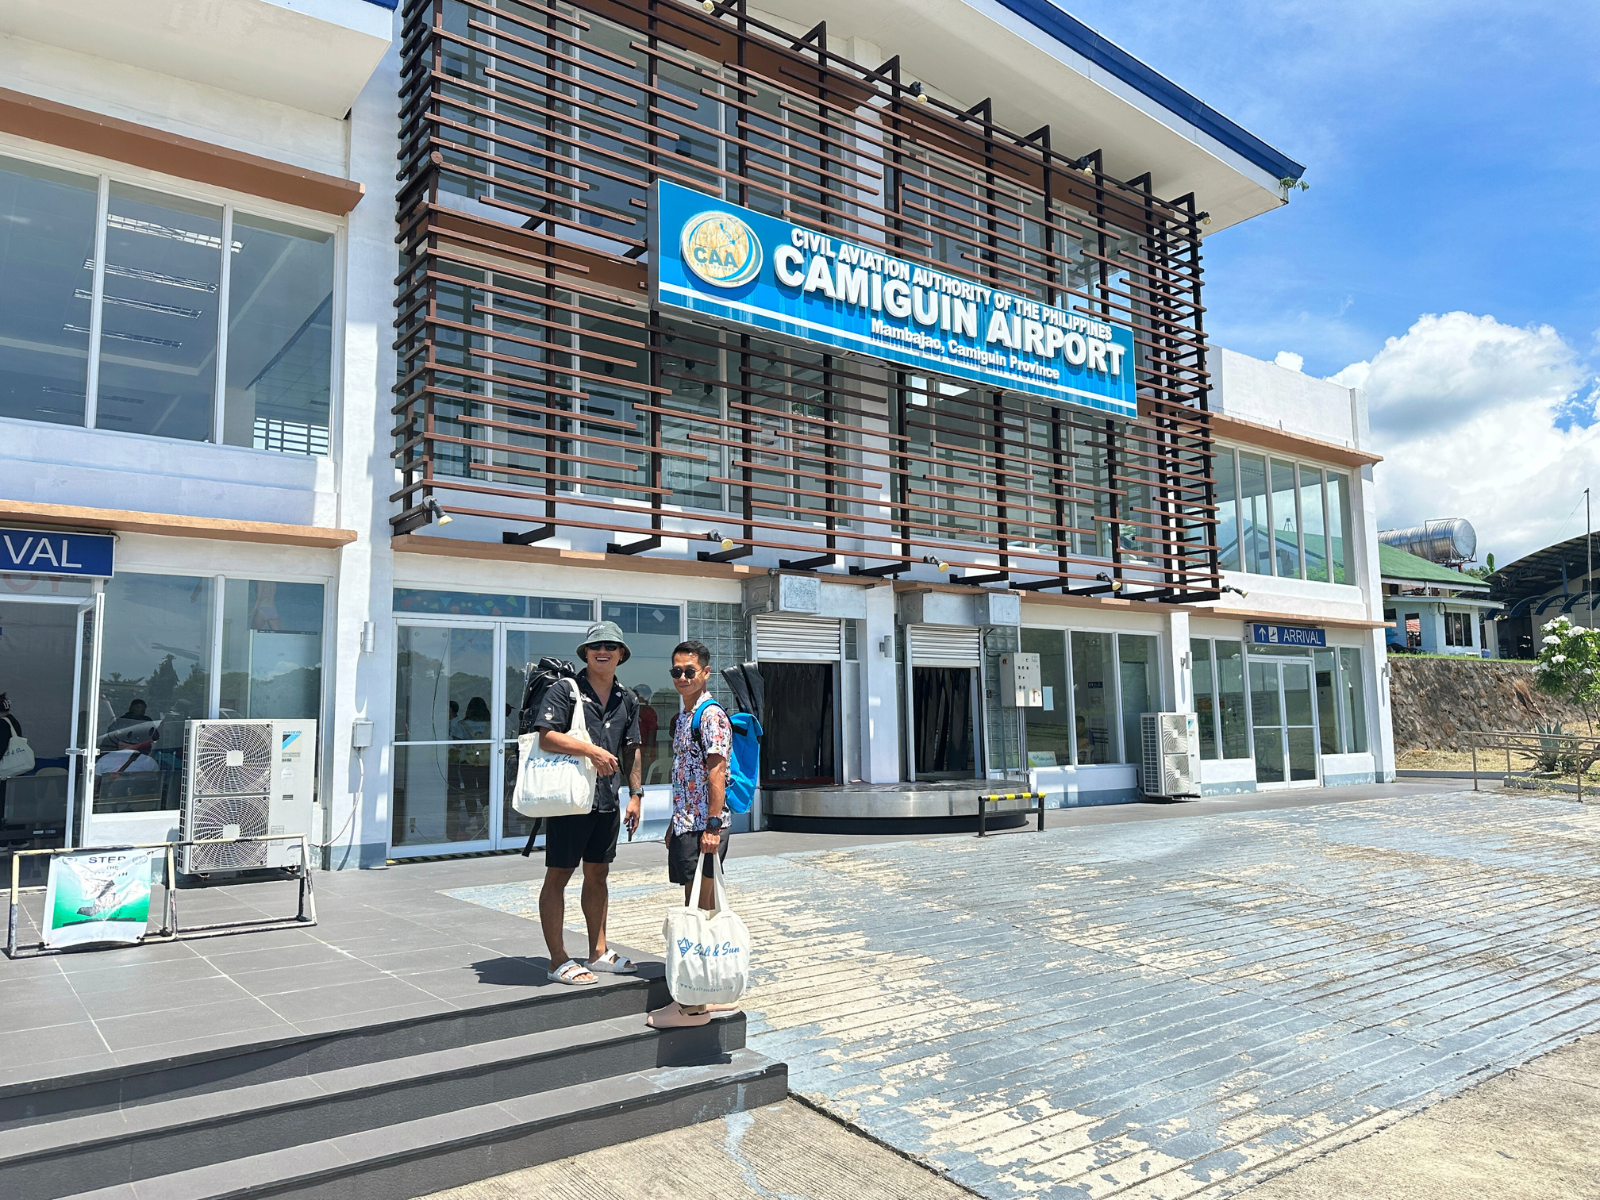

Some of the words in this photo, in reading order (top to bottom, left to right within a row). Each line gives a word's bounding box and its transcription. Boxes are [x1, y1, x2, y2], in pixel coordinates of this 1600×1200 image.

[693, 246, 739, 269] CAA
[791, 228, 836, 258] CIVIL
[838, 243, 911, 281] AVIATION
[912, 267, 992, 305] AUTHORITY
[993, 292, 1012, 313] OF
[1014, 299, 1040, 320] THE
[1042, 307, 1112, 341] PHILIPPINES
[774, 244, 978, 338] CAMIGUIN
[986, 311, 1125, 376] AIRPORT
[871, 318, 945, 354] Mambajao,
[948, 340, 1007, 367] Camiguin
[1009, 354, 1060, 380] Province
[3, 535, 82, 568] VAL
[1283, 629, 1322, 644] ARRIVAL
[562, 754, 580, 766] Sun
[693, 943, 711, 956] Salt
[712, 943, 720, 956] &
[721, 941, 740, 956] Sun
